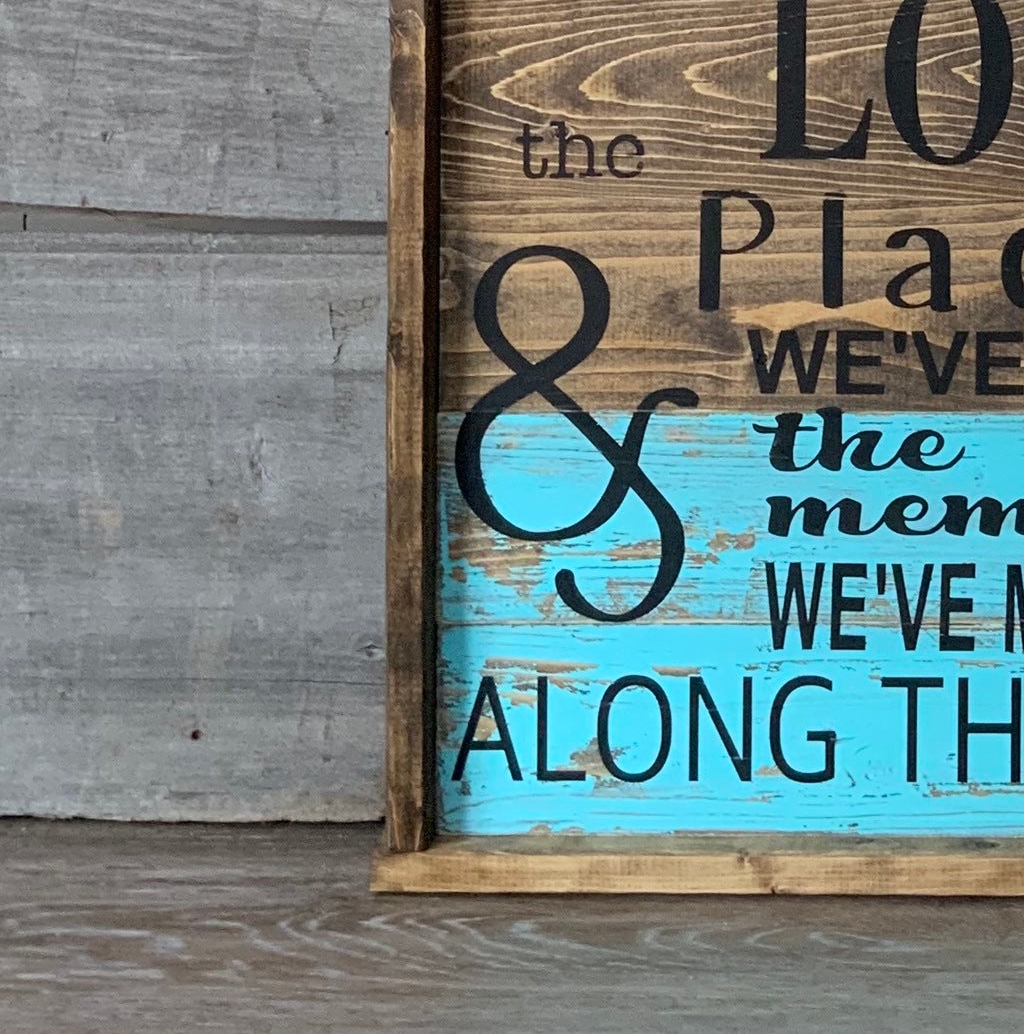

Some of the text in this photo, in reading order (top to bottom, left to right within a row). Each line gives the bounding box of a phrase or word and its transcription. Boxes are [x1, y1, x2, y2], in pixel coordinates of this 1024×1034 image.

[516, 121, 644, 178] the
[749, 330, 1023, 394] WE'VE
[454, 244, 699, 622] &
[754, 407, 965, 472] the
[765, 562, 976, 650] WE'VE
[452, 674, 836, 783] ALONG
